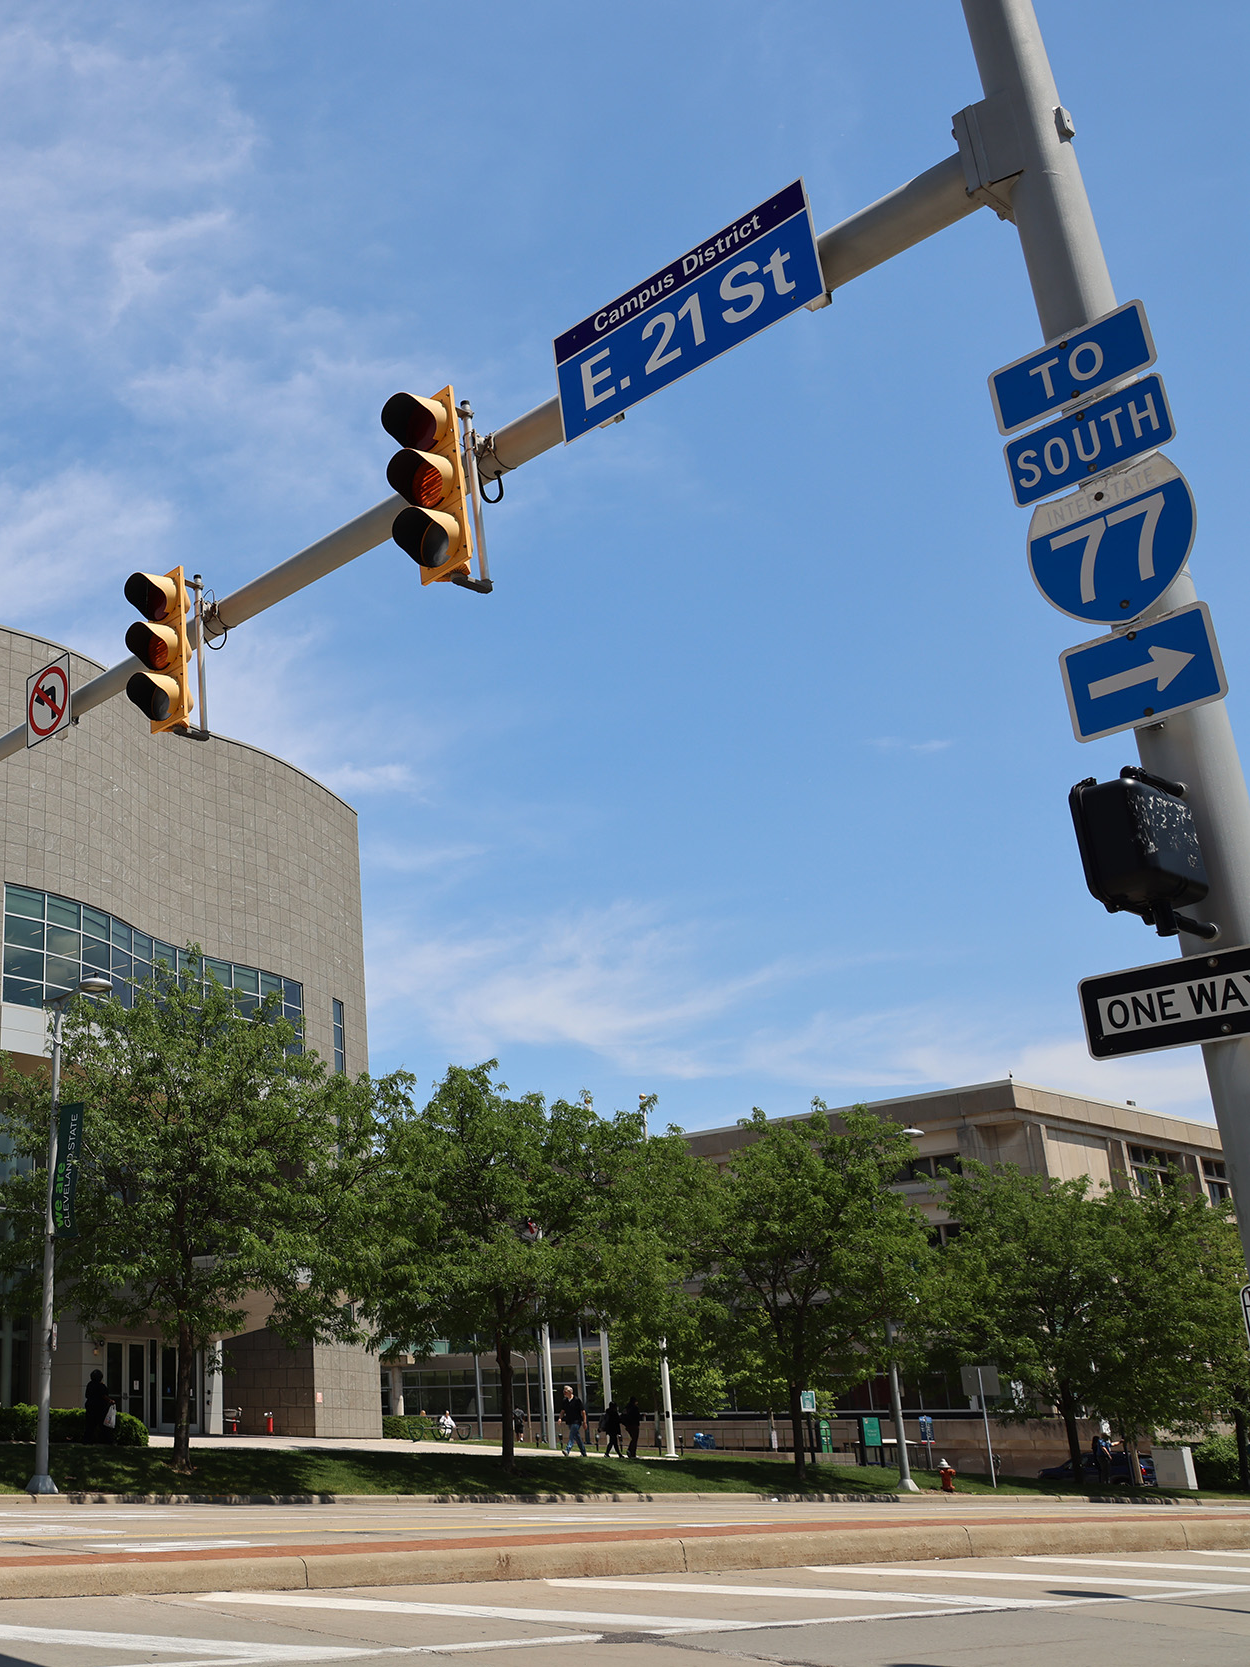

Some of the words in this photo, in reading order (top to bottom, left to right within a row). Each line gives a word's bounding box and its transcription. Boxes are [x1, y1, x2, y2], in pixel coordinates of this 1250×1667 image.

[594, 274, 675, 332] Campus
[682, 214, 761, 276] District
[580, 347, 631, 411] E.
[641, 292, 706, 375] 21
[719, 247, 796, 324] St
[1028, 341, 1104, 399] TO
[1017, 392, 1160, 488] SOUTH
[1049, 491, 1166, 604] 77
[1106, 988, 1181, 1029] ONE
[1187, 975, 1250, 1015] WA
[68, 1113, 79, 1150] STATE
[55, 1162, 66, 1194] are
[54, 1199, 64, 1228] we
